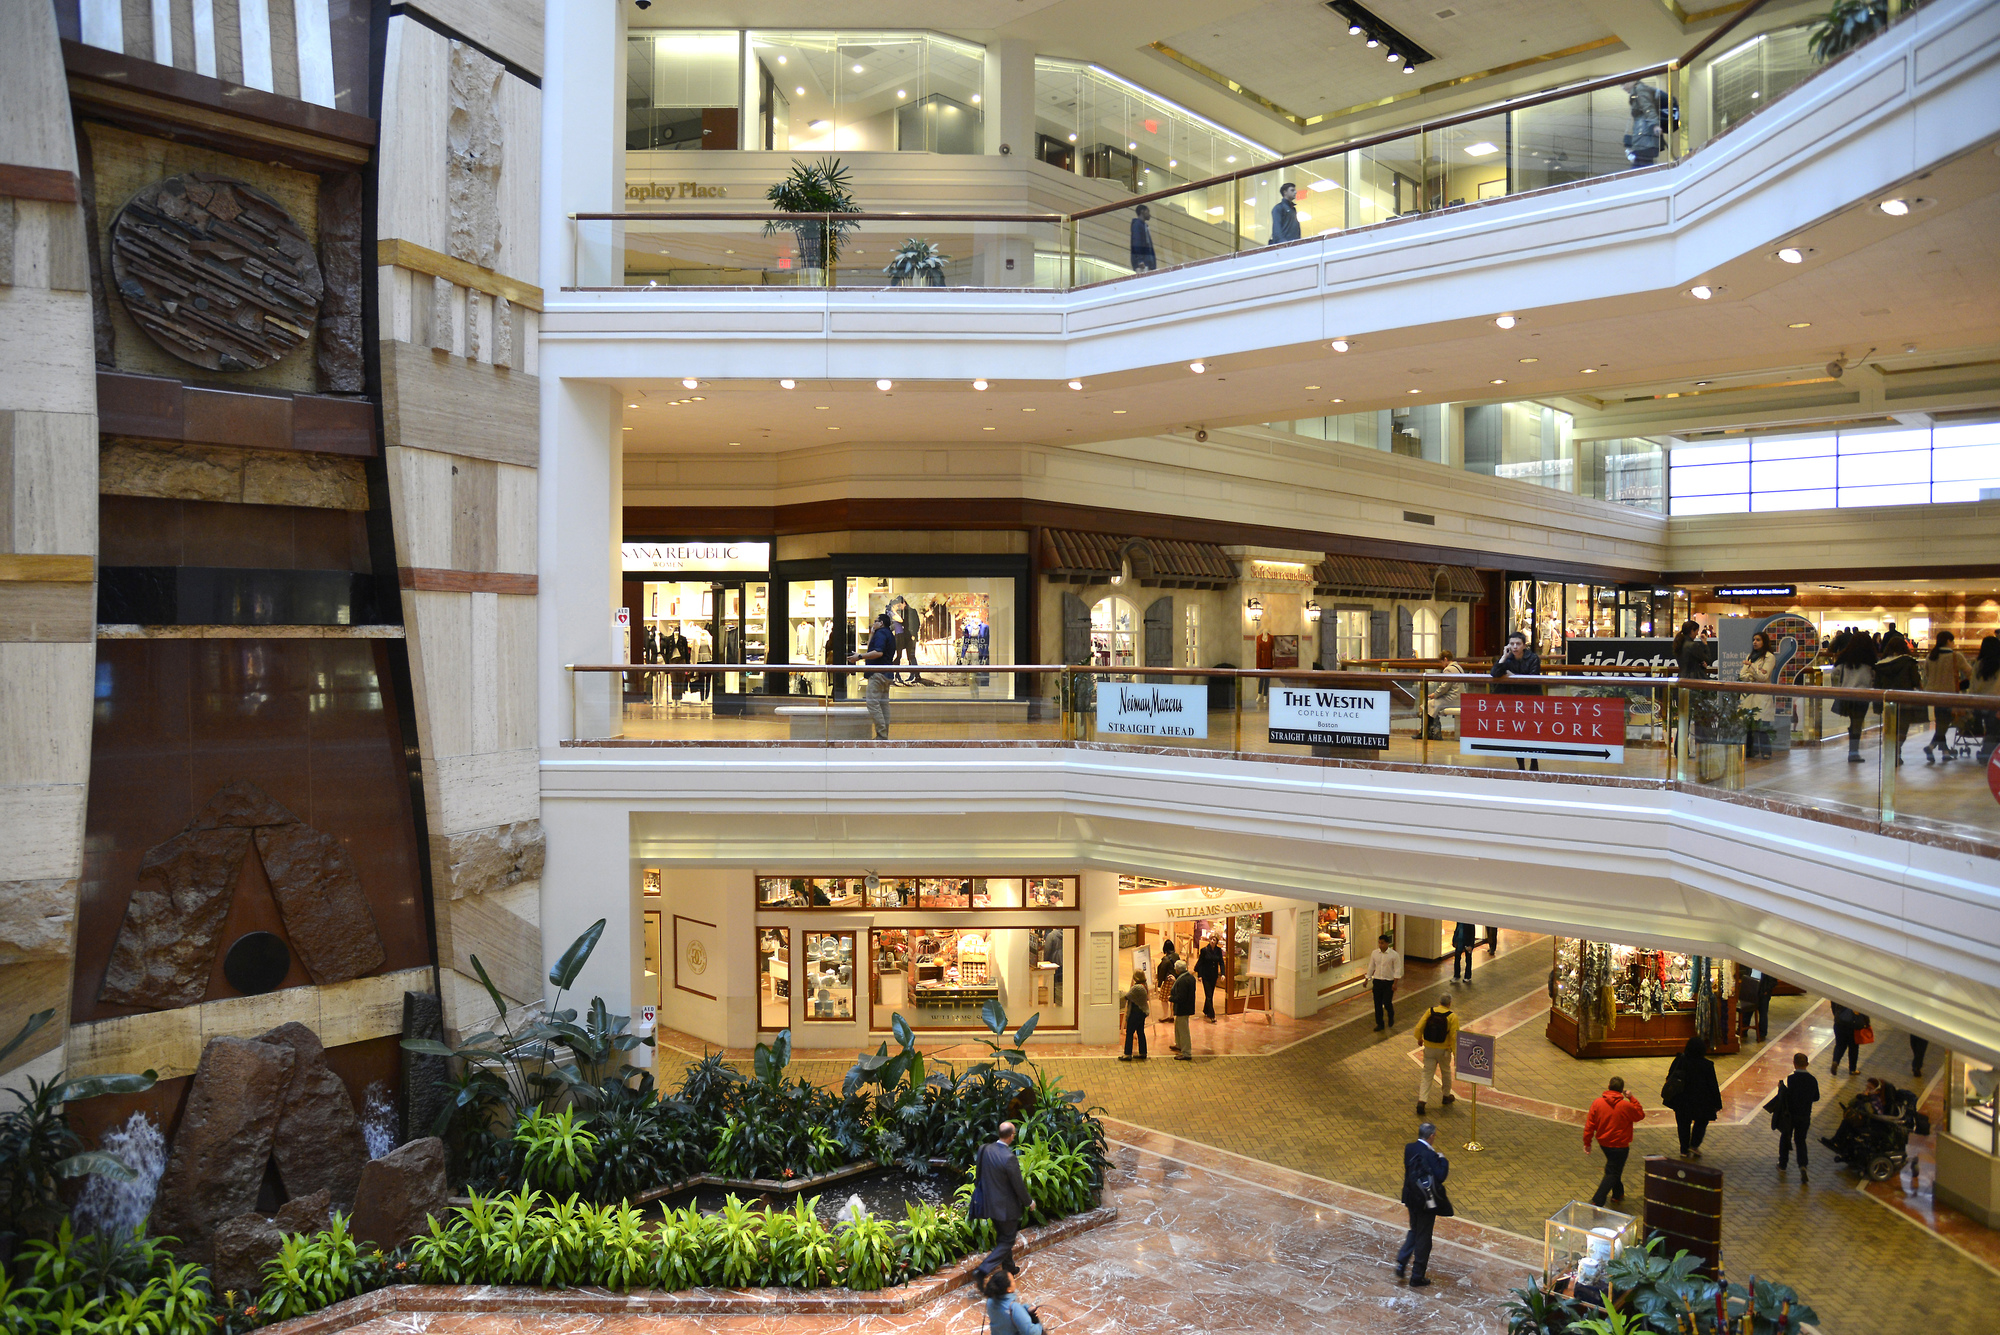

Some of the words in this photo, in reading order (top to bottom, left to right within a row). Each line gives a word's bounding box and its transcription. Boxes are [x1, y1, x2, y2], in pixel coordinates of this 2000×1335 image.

[678, 182, 727, 198] Place
[666, 547, 739, 560] REPUBLIC
[1118, 686, 1151, 715] Neiman
[1149, 687, 1183, 718] Marcus
[1283, 691, 1312, 707] THE
[1316, 692, 1375, 710] WESTIN
[1478, 699, 1601, 717] BARNEYS
[1298, 710, 1329, 718] COPLEY
[1333, 711, 1360, 719] PLACE
[1108, 722, 1156, 734] STRAIGHT
[1160, 726, 1195, 736] AHEAD
[1270, 731, 1306, 742] STRAIGHT
[1307, 734, 1334, 744] AHEAD,
